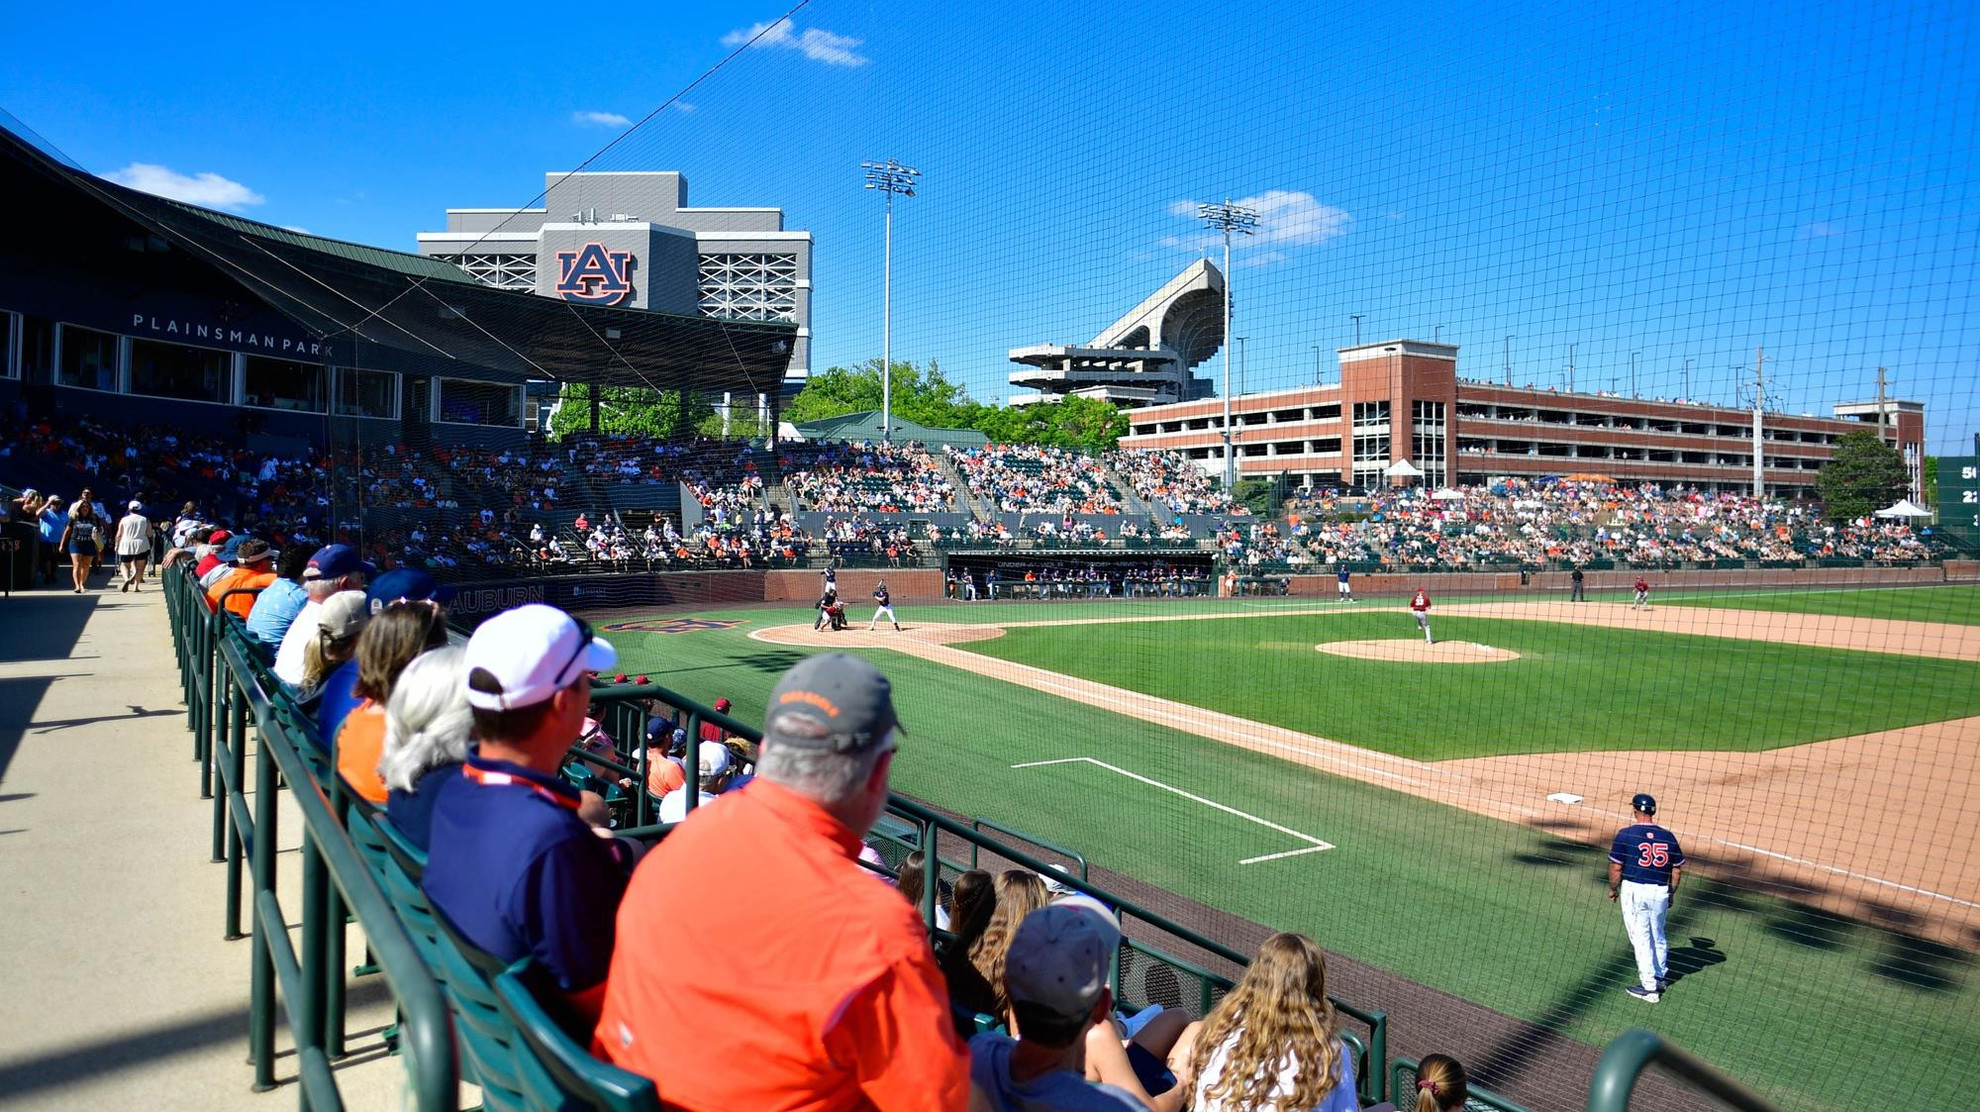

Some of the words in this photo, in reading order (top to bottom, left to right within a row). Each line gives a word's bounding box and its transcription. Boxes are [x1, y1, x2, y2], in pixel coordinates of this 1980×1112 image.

[133, 314, 275, 348] PLAINSMAN
[283, 340, 334, 358] PARK
[448, 585, 544, 615] AUBURN
[1638, 842, 1668, 867] 35
